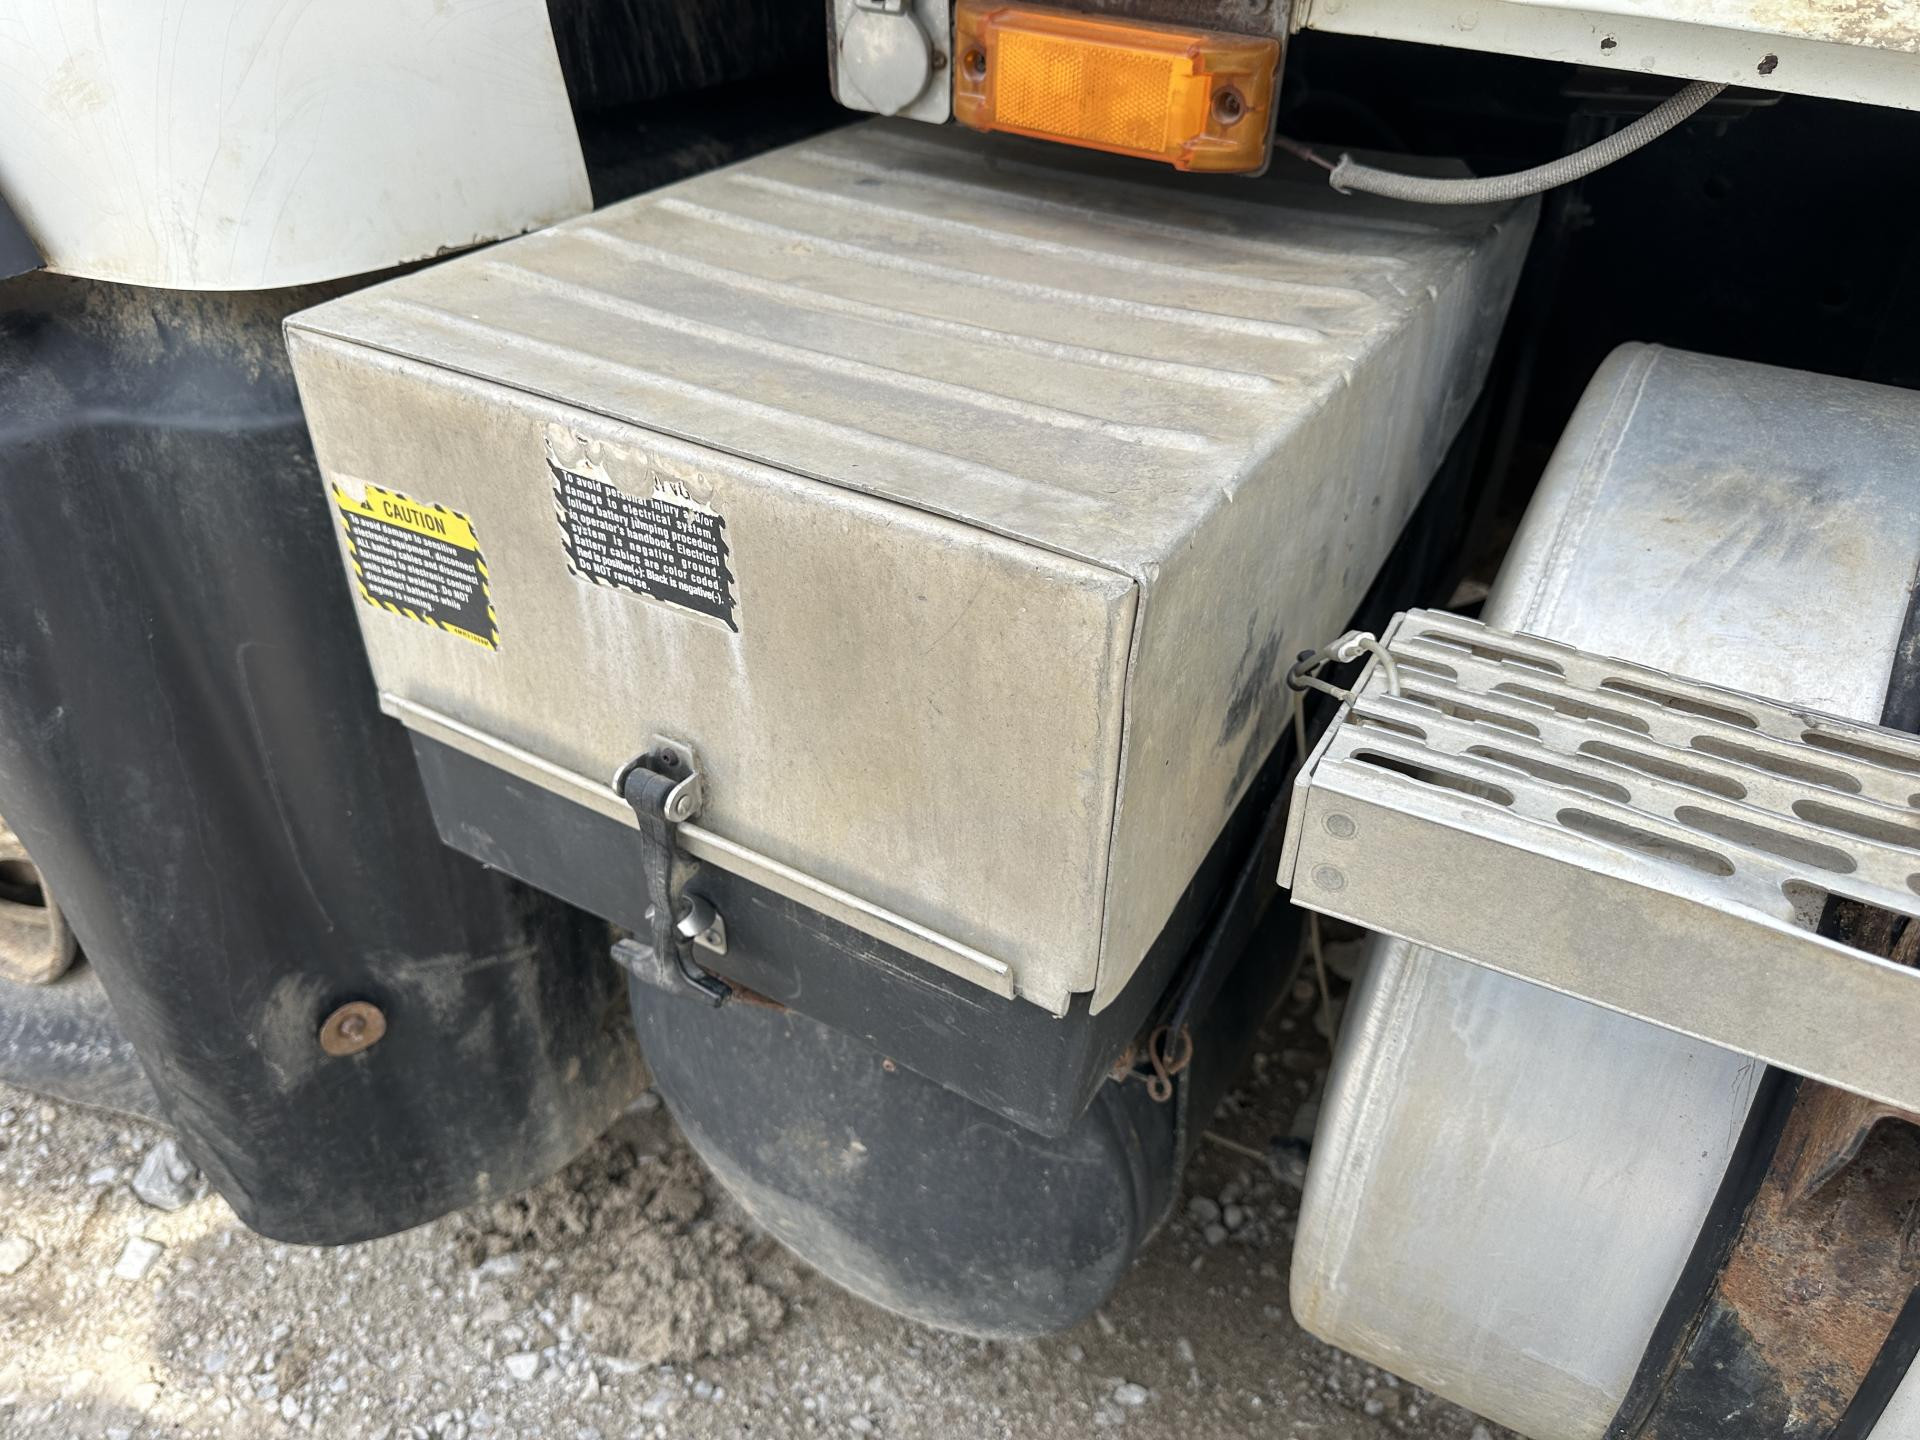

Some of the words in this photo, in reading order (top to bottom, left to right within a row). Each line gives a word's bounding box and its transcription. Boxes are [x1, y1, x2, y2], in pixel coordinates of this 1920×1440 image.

[383, 501, 446, 535] CAUTION
[563, 472, 573, 483] To
[577, 479, 602, 492] avoid
[651, 499, 680, 518] injury
[683, 509, 714, 527] ad/or
[565, 485, 602, 505] damage
[608, 498, 617, 509] to
[623, 504, 671, 526] electrical
[350, 514, 359, 524] To
[361, 518, 381, 531] avoid
[383, 524, 412, 541] damage
[413, 533, 421, 543] to
[424, 537, 457, 556] sensitive
[567, 498, 594, 515] follow
[596, 507, 628, 527] battery
[631, 517, 669, 540] jumping
[671, 531, 717, 553] procedure
[580, 513, 624, 536] operator's
[627, 527, 674, 552] handbook.
[677, 543, 720, 566] Electrical
[354, 527, 390, 544] electronic
[435, 552, 476, 573] disconnect
[357, 537, 370, 549] ALL
[371, 542, 396, 560] battery
[398, 550, 427, 566] cables
[424, 558, 437, 570] and
[439, 563, 478, 585] disconnect
[360, 549, 396, 567] harnesses
[397, 560, 406, 571] to
[408, 564, 444, 584] electronic
[446, 576, 472, 593] control
[572, 523, 606, 542] system
[613, 534, 622, 546] is
[629, 542, 674, 563] negative
[681, 554, 721, 579] ground.
[574, 534, 606, 555] Battery
[610, 546, 641, 563] cables
[644, 559, 659, 571] are
[664, 563, 688, 580] color
[691, 572, 723, 592] coded.
[577, 547, 593, 561] Red
[594, 552, 602, 563] is
[646, 571, 669, 586] Black
[670, 577, 678, 588] is
[363, 561, 381, 575] units
[382, 564, 406, 581] before
[442, 584, 452, 595] Do
[454, 589, 469, 602] NOT
[366, 571, 404, 589] disconnect
[406, 582, 439, 602] batteries
[441, 596, 461, 611] while
[370, 583, 393, 599] engine
[395, 591, 402, 601] is
[579, 558, 591, 571] Do
[594, 564, 611, 578] NOT
[613, 571, 651, 591] reverse.
